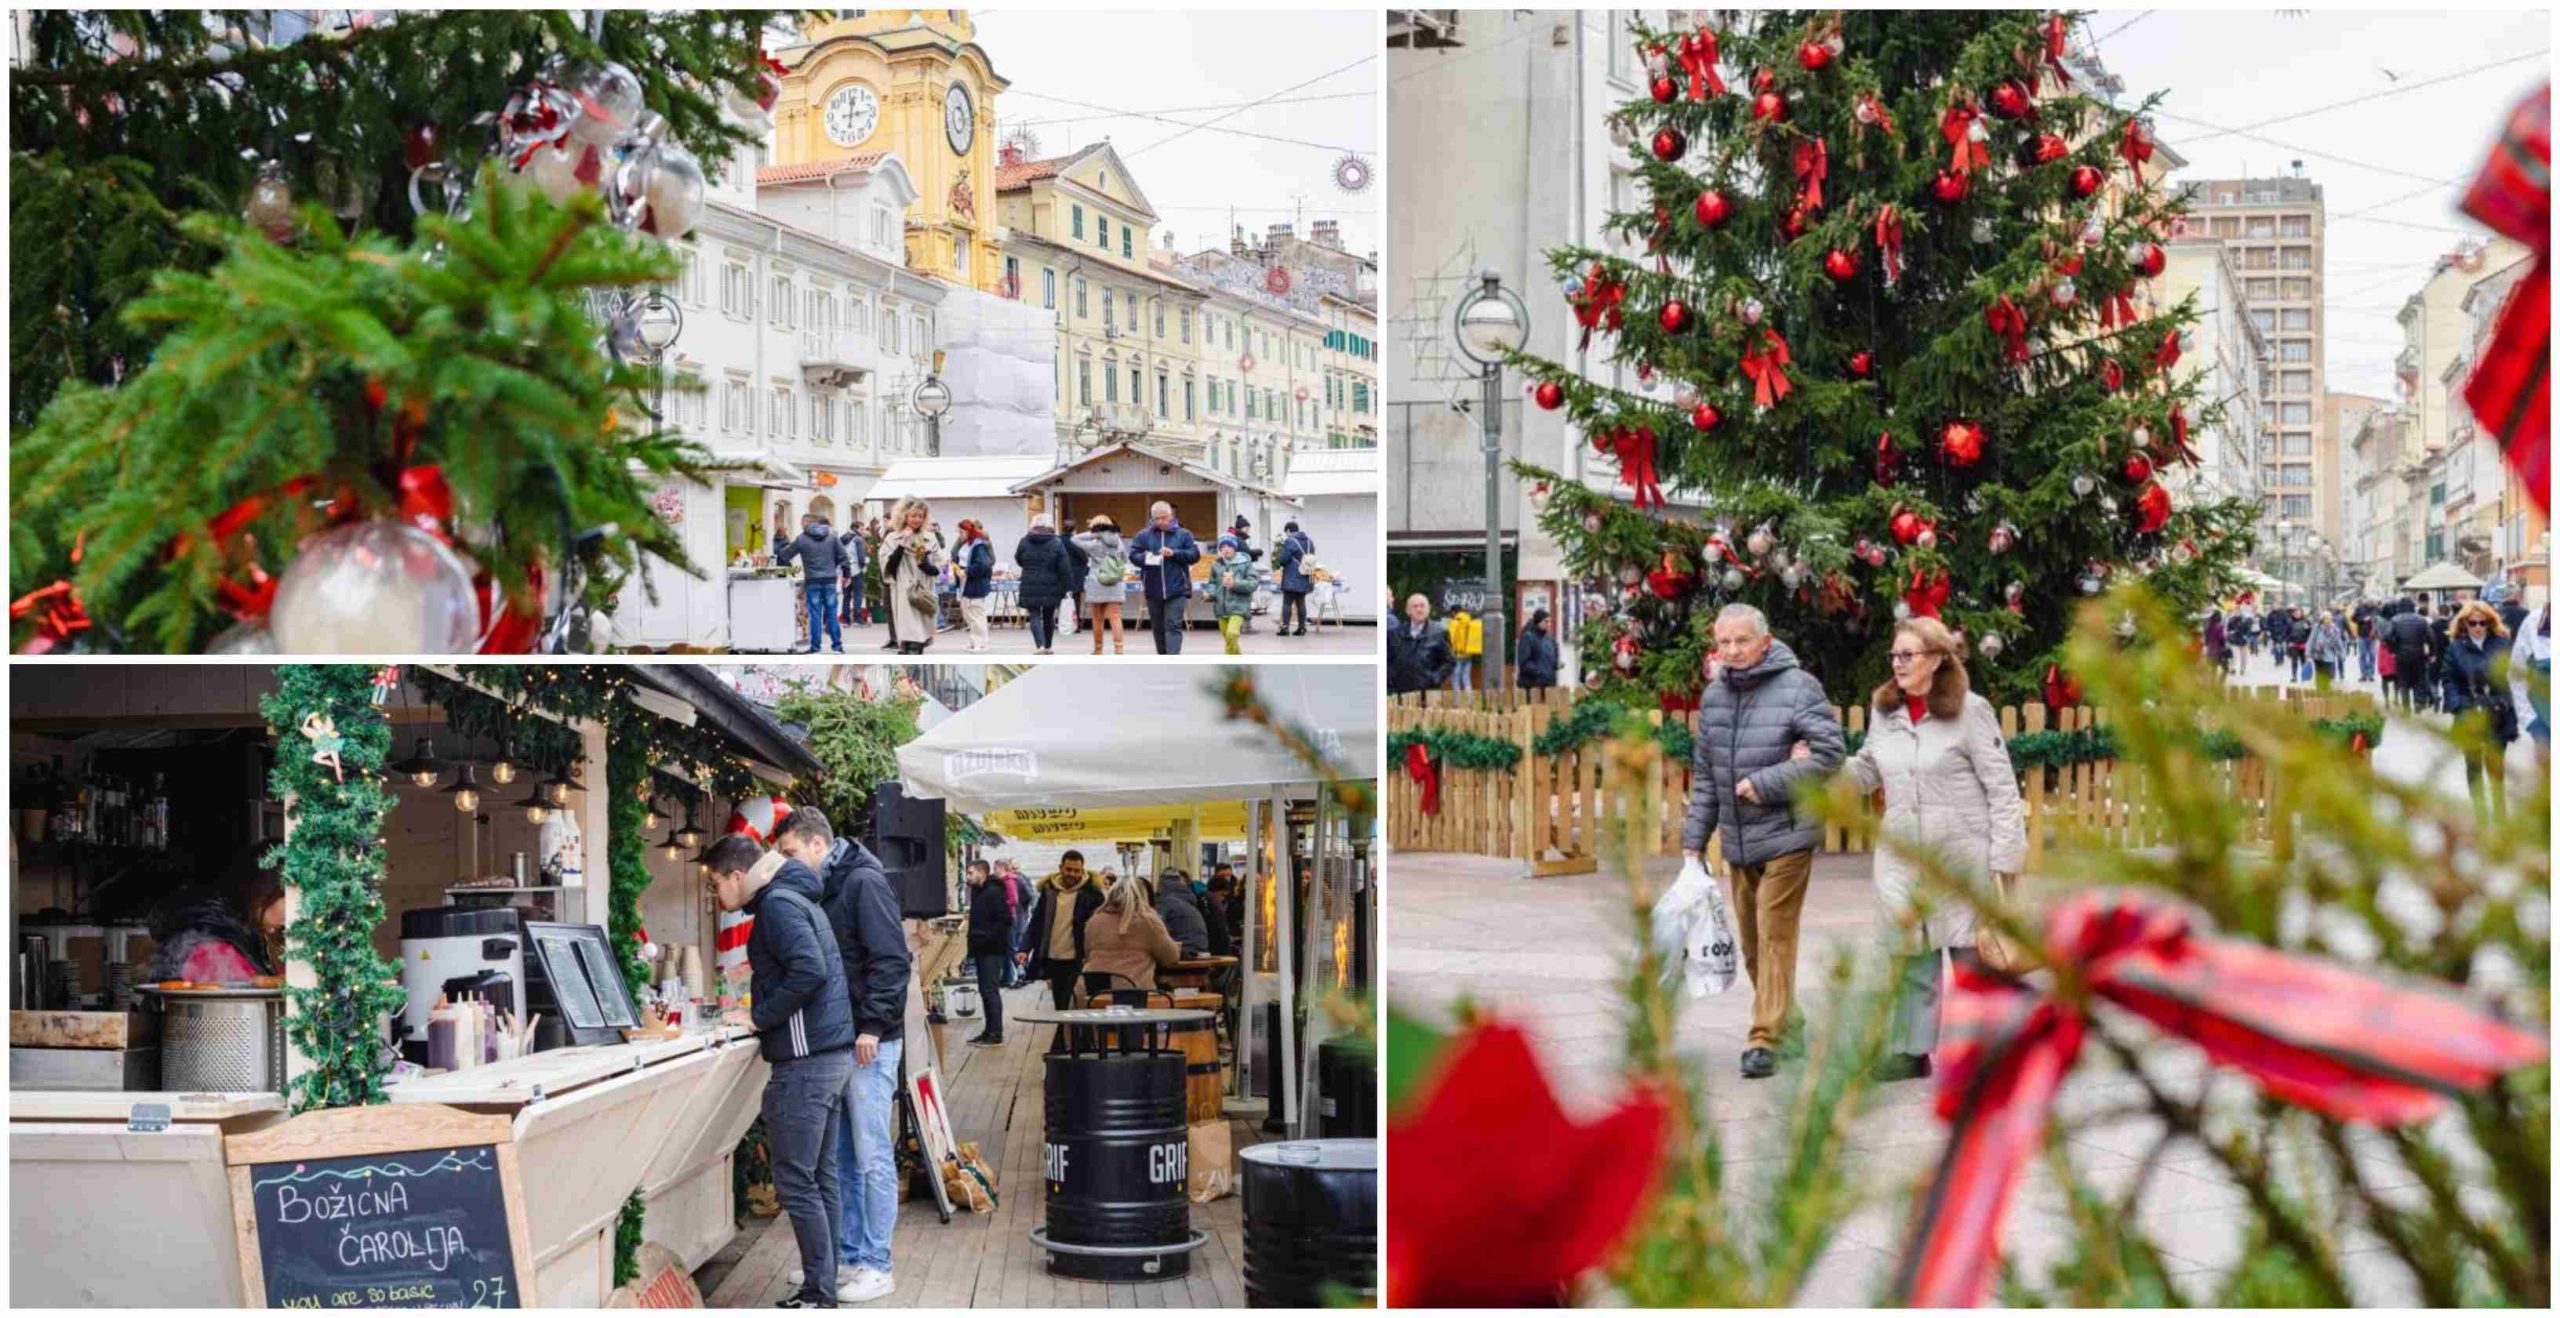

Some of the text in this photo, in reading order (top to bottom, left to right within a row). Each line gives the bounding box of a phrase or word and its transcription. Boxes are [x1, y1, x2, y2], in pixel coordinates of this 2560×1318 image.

[1045, 1143, 1069, 1182] RIF
[1150, 1141, 1187, 1183] GRIF
[339, 1223, 465, 1271] ČAROLIJA
[331, 1290, 363, 1307] are
[367, 1287, 386, 1303] so
[389, 1284, 436, 1300] basic
[472, 1276, 507, 1309] 27
